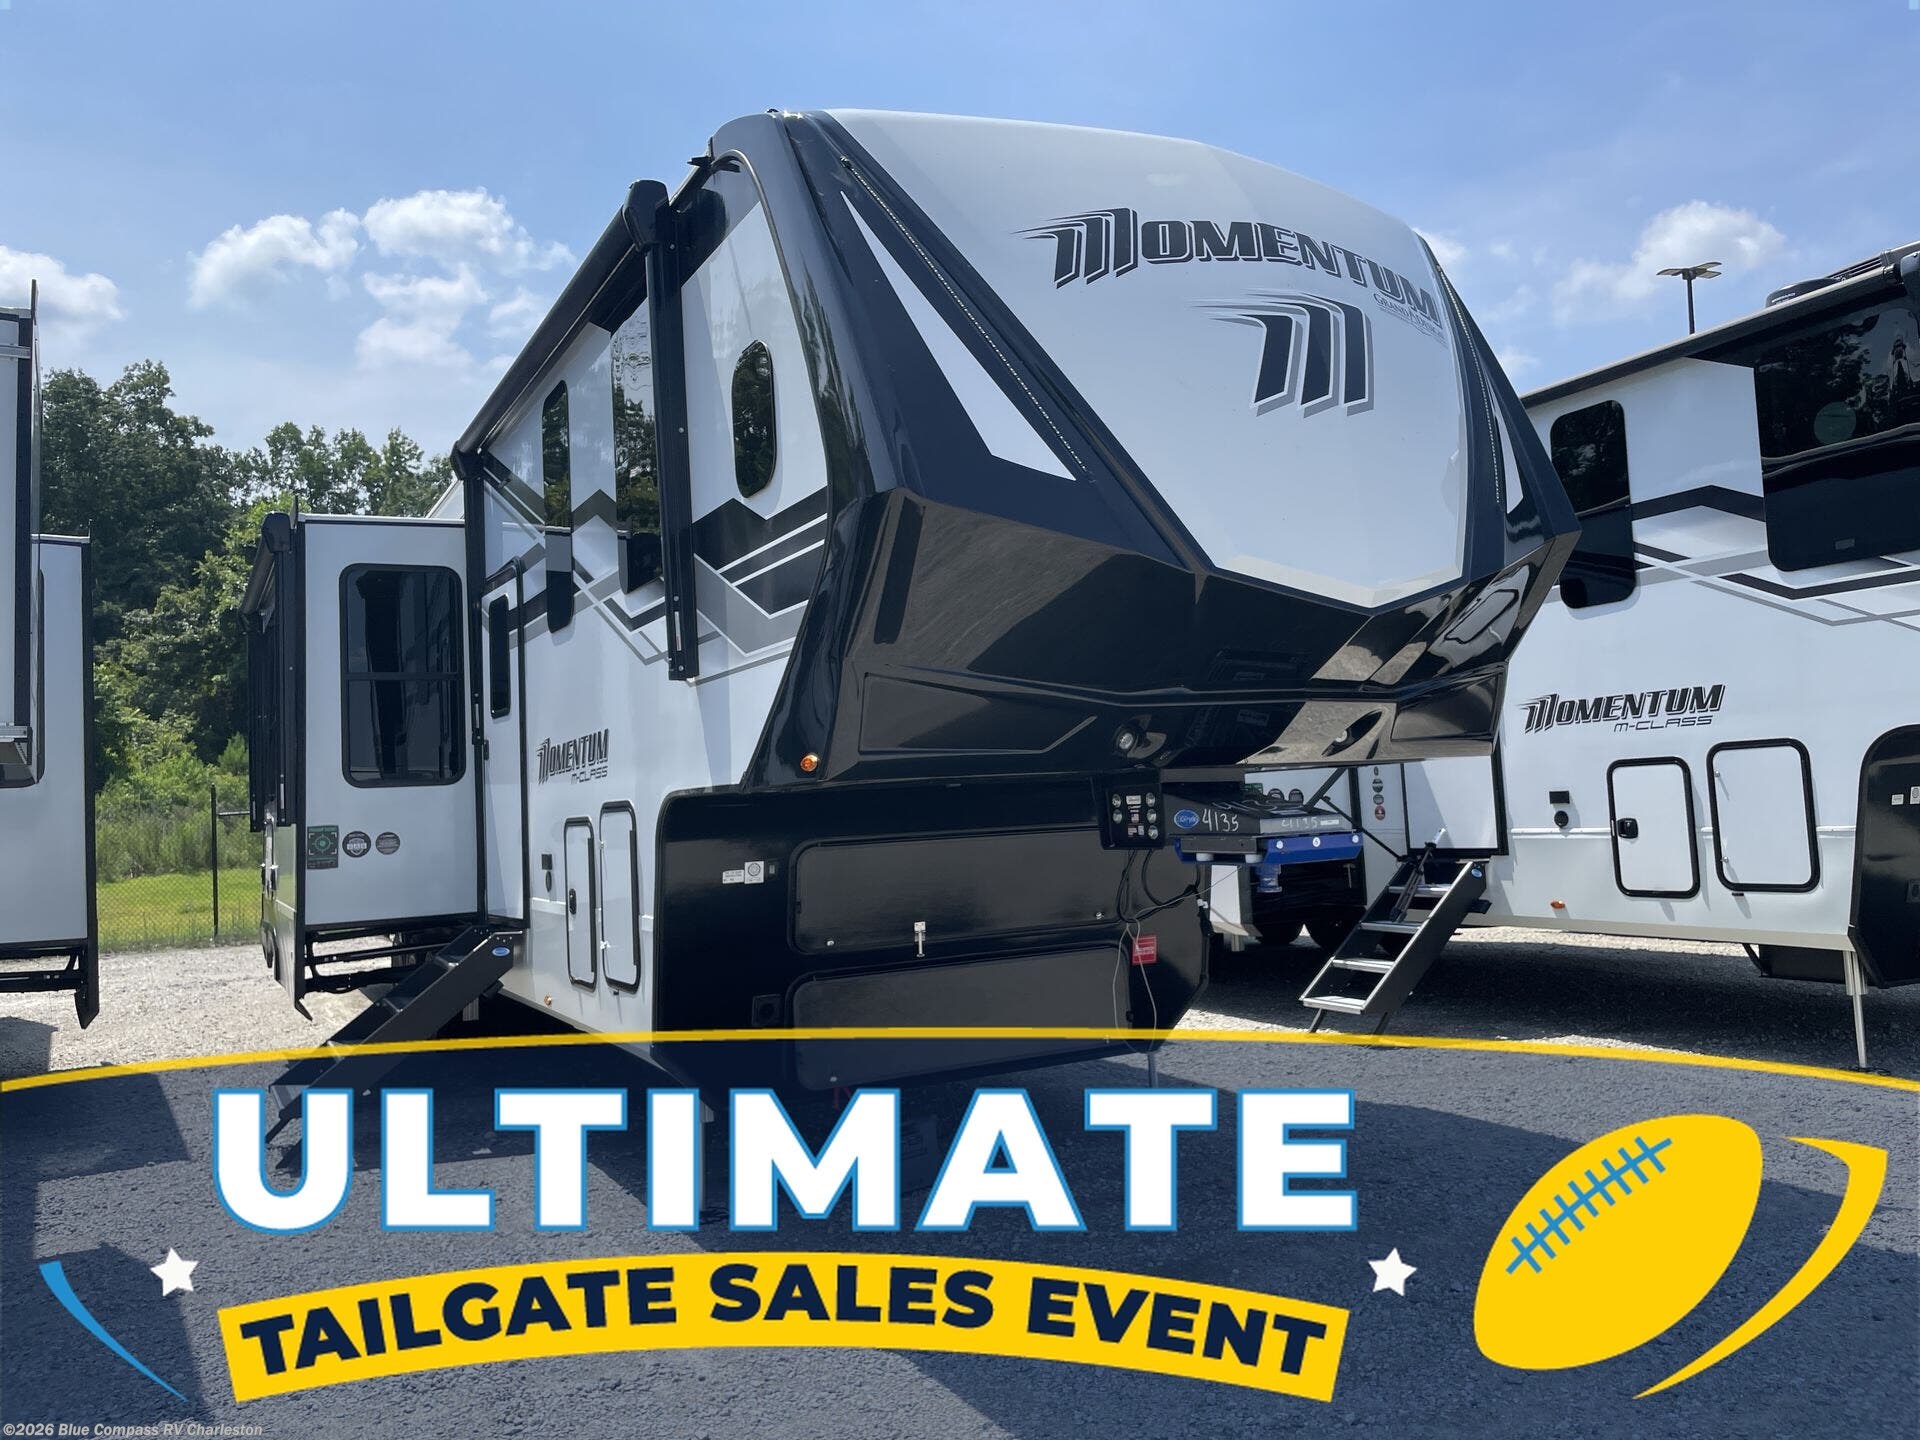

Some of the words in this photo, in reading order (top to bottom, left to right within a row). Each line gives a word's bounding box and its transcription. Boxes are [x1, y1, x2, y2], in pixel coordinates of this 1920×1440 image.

[1012, 207, 1442, 329] MOMENTUM
[1520, 684, 1725, 733] MOMENTUM
[536, 728, 609, 785] MOMENTUM
[1202, 808, 1239, 831] 4135
